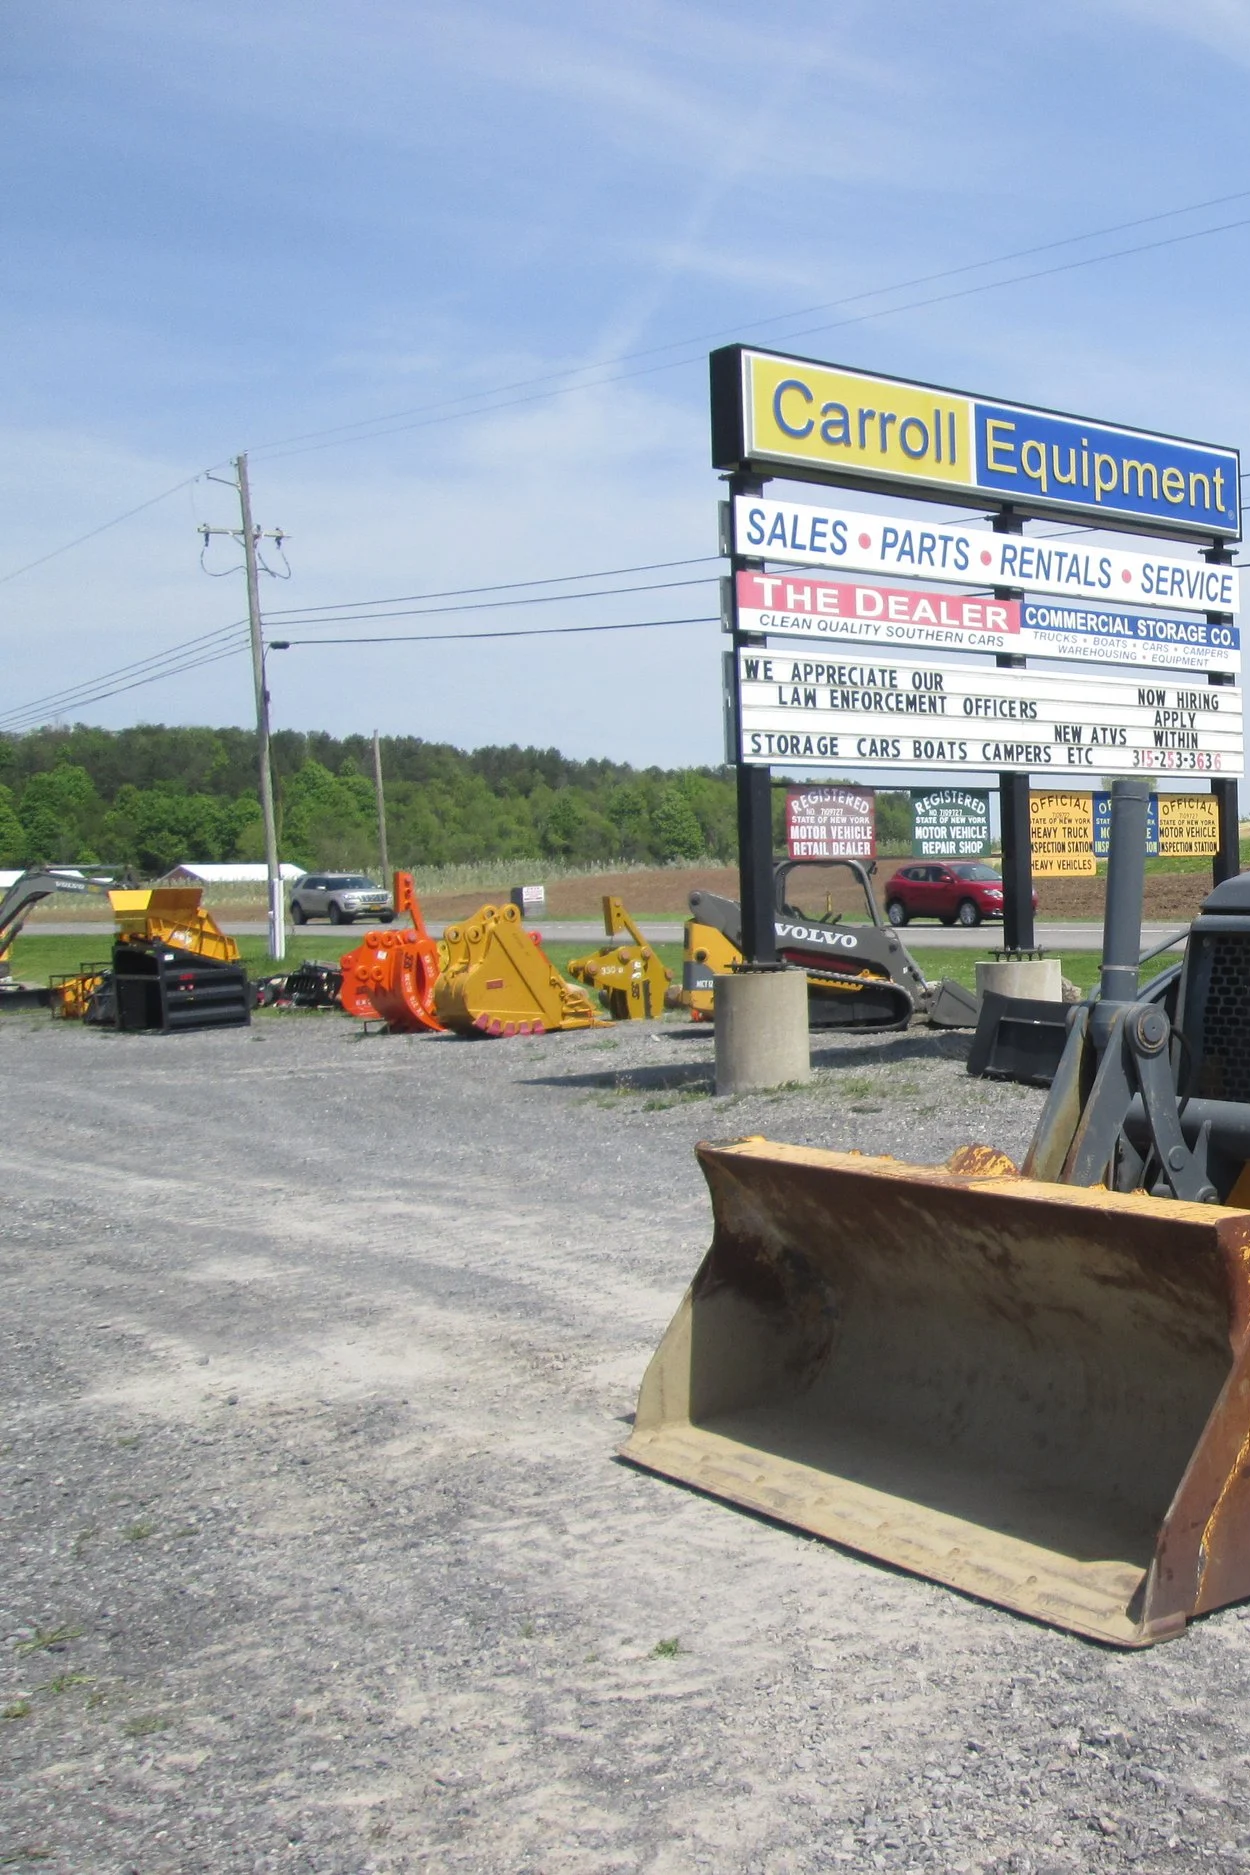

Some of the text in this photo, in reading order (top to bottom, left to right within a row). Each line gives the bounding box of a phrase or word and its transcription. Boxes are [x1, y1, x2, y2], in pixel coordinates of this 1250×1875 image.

[772, 378, 1226, 512] Carroll Equipment
[747, 508, 1233, 604] SALES PARTS RENTALS SERVICE
[753, 577, 1009, 632] THE DEALER
[759, 614, 1004, 647] CLEAN QUALITY SOUTHERN CARS
[1025, 607, 1235, 646] COMMERCIAL STORAGE CO.
[1033, 631, 1229, 660] TRUCKS BOATS CARS CAMPERS
[1058, 645, 1209, 668] WAREHOUSING EQUIPMENT
[744, 658, 944, 692] WE APPRECIATE OUR
[778, 685, 1037, 720] LAW ENFORCEMENT OFFICERS
[1138, 688, 1219, 711] NOW HIRING
[1154, 710, 1196, 729] APPLY
[1054, 725, 1127, 745] NEW ATVS
[1153, 730, 1198, 749] WITHIN
[751, 733, 1093, 765] STORAGE CARS BOATS CAMPERS ETC
[1132, 749, 1222, 771] 315-253-3636
[791, 788, 869, 814] REGISTERED
[915, 790, 986, 815] REGISTERED
[1031, 794, 1089, 814] OFFICIAL
[1162, 798, 1213, 815] OFFICIAL
[791, 816, 870, 824] STATE OF NEW YORK
[915, 816, 987, 824] STATE OF NEW YORK
[790, 825, 873, 839] MOTOR VEHICLE
[915, 826, 948, 839] MOTOR
[1031, 827, 1058, 838] HEAVY
[1062, 827, 1089, 838] TRUCK
[1160, 827, 1184, 838] MOTOR
[1186, 827, 1217, 838] VEHICLE
[793, 841, 871, 856] RETAIL DEALER
[922, 841, 984, 855] REPAIR SHOP
[1067, 841, 1093, 853] STATION
[1159, 841, 1193, 853] INSPECTION
[1194, 841, 1218, 853] STATION
[1057, 859, 1092, 870] VEHICLES
[774, 922, 858, 948] VOLVO
